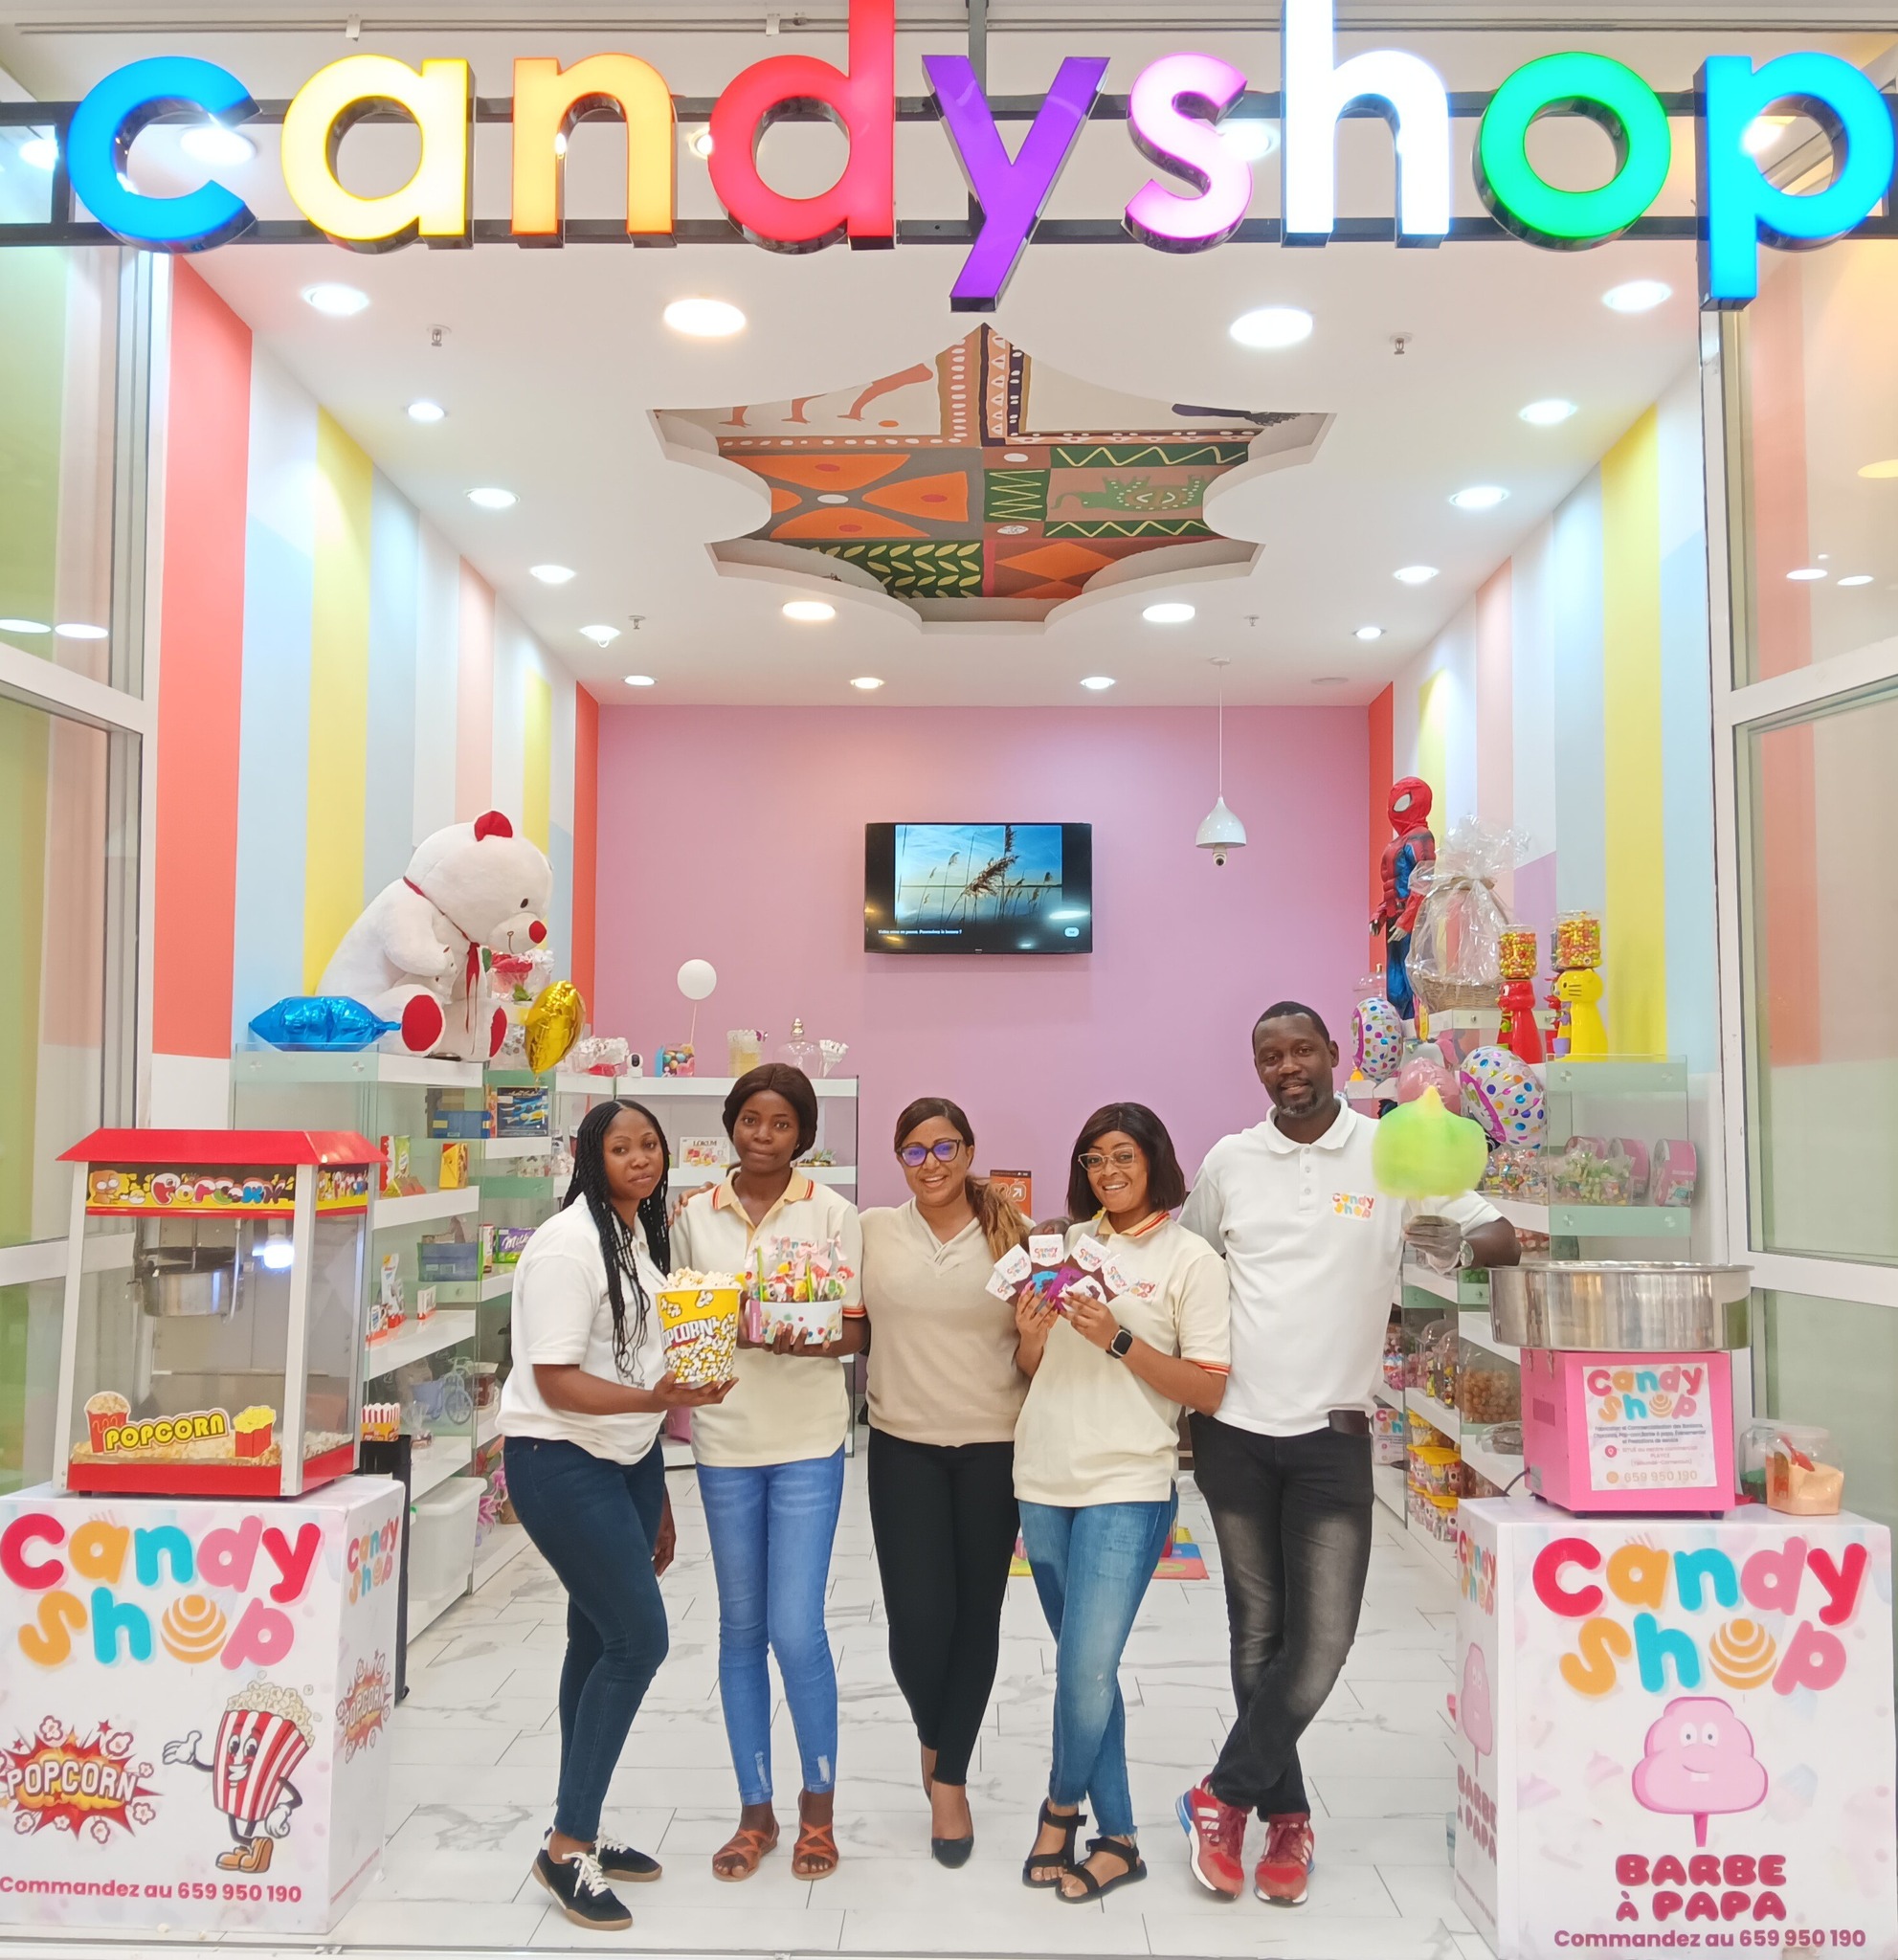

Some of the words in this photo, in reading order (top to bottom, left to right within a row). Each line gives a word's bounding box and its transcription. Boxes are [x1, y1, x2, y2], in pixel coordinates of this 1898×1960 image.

[67, 0, 1895, 310] candyshop
[105, 1413, 226, 1451] POPCORN
[1650, 1471, 1674, 1481] 950
[6, 1759, 139, 1806] POPCORN
[1616, 1854, 1787, 1886] BARBE
[0, 1876, 140, 1898] Commandez
[144, 1883, 172, 1898] au
[177, 1882, 217, 1900] 659
[222, 1883, 262, 1902] 950
[267, 1885, 302, 1904] 190
[1652, 1891, 1787, 1922] PAPA
[1554, 1929, 1701, 1948] Commandez
[1705, 1933, 1734, 1948] au
[1739, 1929, 1780, 1948] 659
[1784, 1929, 1826, 1948] 950
[1830, 1929, 1866, 1948] 190
